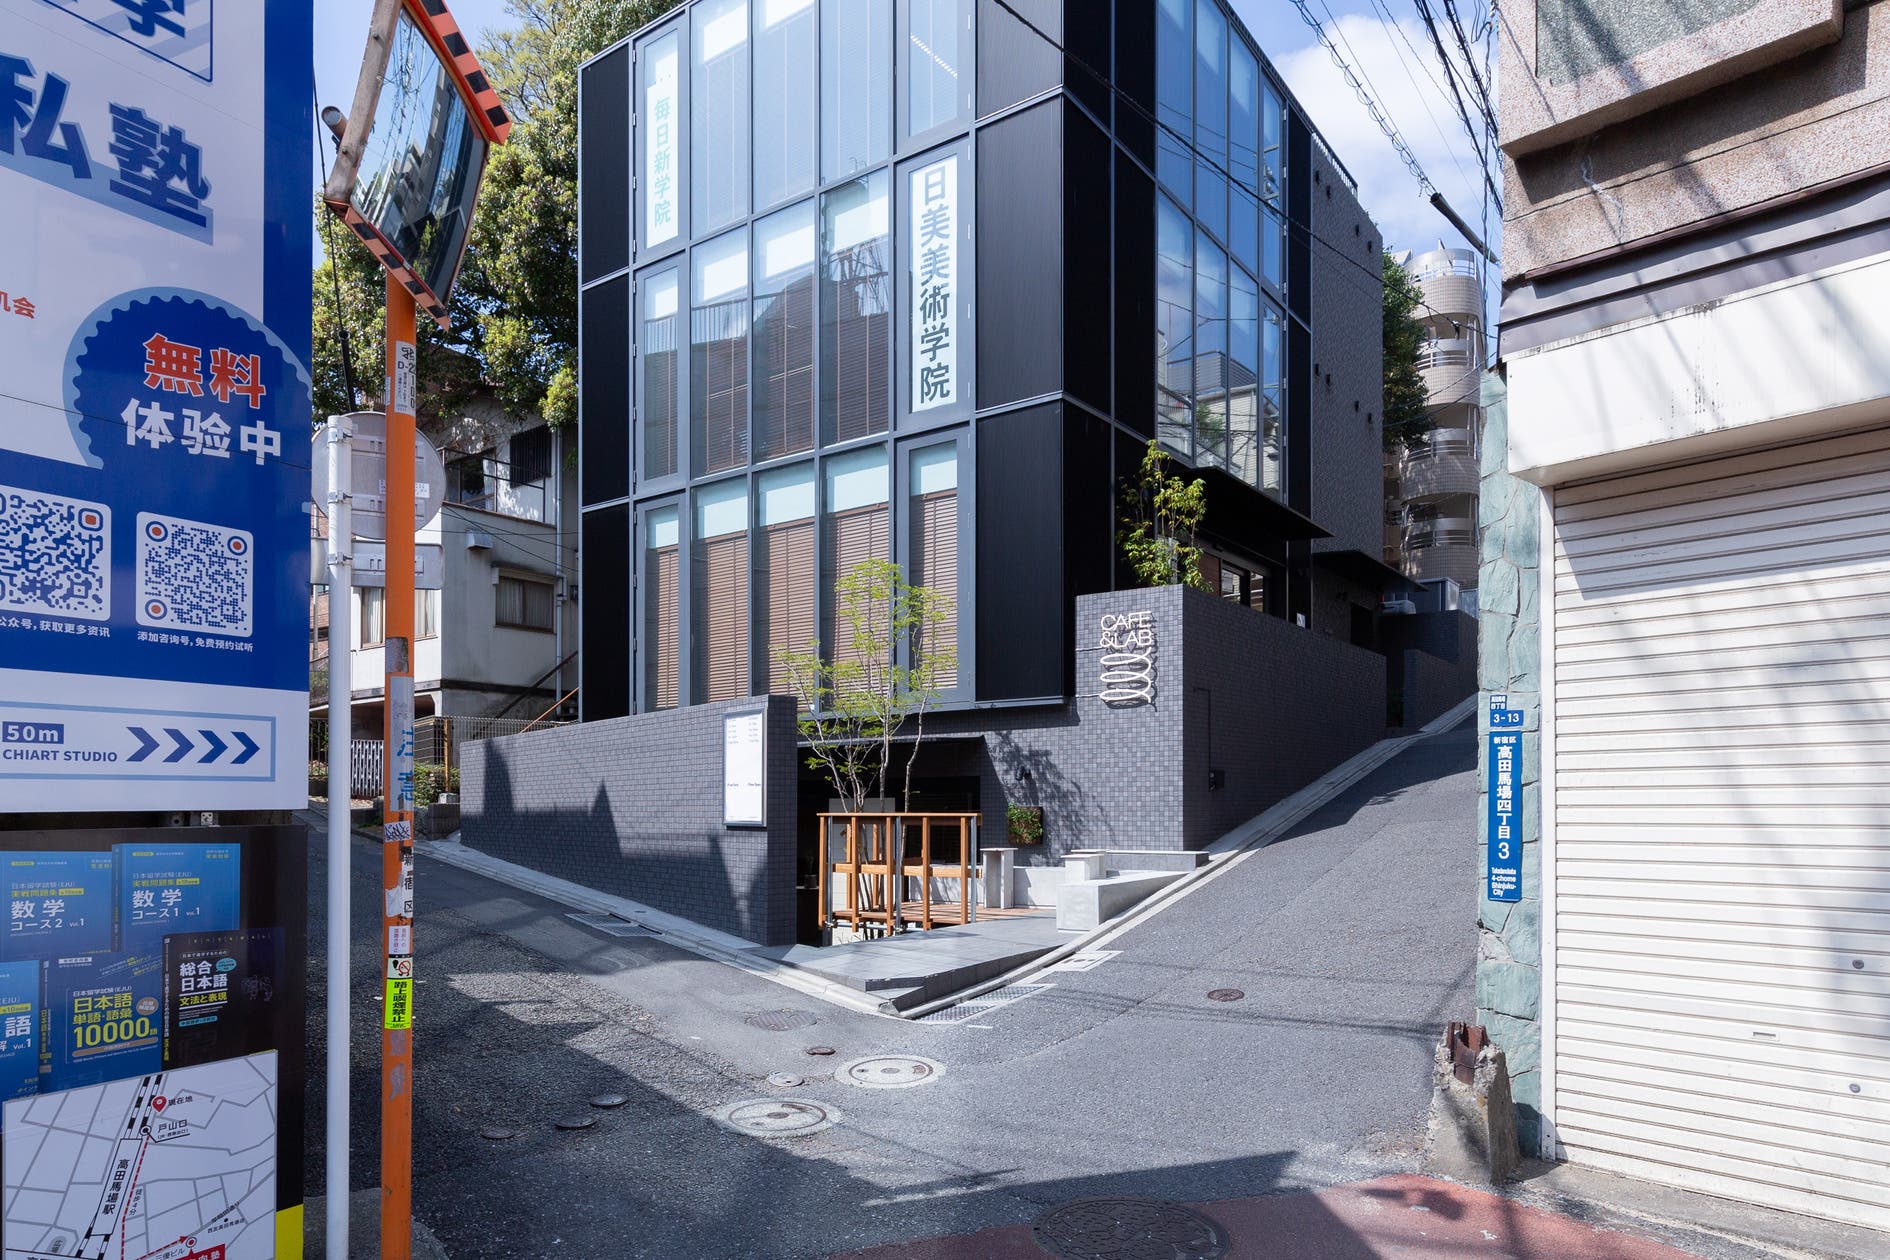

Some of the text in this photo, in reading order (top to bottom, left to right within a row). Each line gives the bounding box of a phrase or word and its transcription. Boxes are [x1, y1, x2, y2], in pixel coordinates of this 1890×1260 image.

[919, 164, 951, 404] 日美美術学院
[143, 333, 265, 409] 無料
[121, 398, 282, 466] 体验中
[1101, 610, 1152, 631] CAFE
[1100, 629, 1153, 648] &LAB
[1493, 713, 1520, 723] 3-13
[3, 748, 118, 762] CHIART STUDIO
[1493, 889, 1504, 898] City
[179, 960, 213, 977] 総合
[181, 973, 229, 992] 日本語
[74, 992, 133, 1013] 日本語
[4, 1014, 32, 1038] 語
[168, 1095, 194, 1107] 現在地
[101, 1158, 132, 1215] 高田馬場駅
